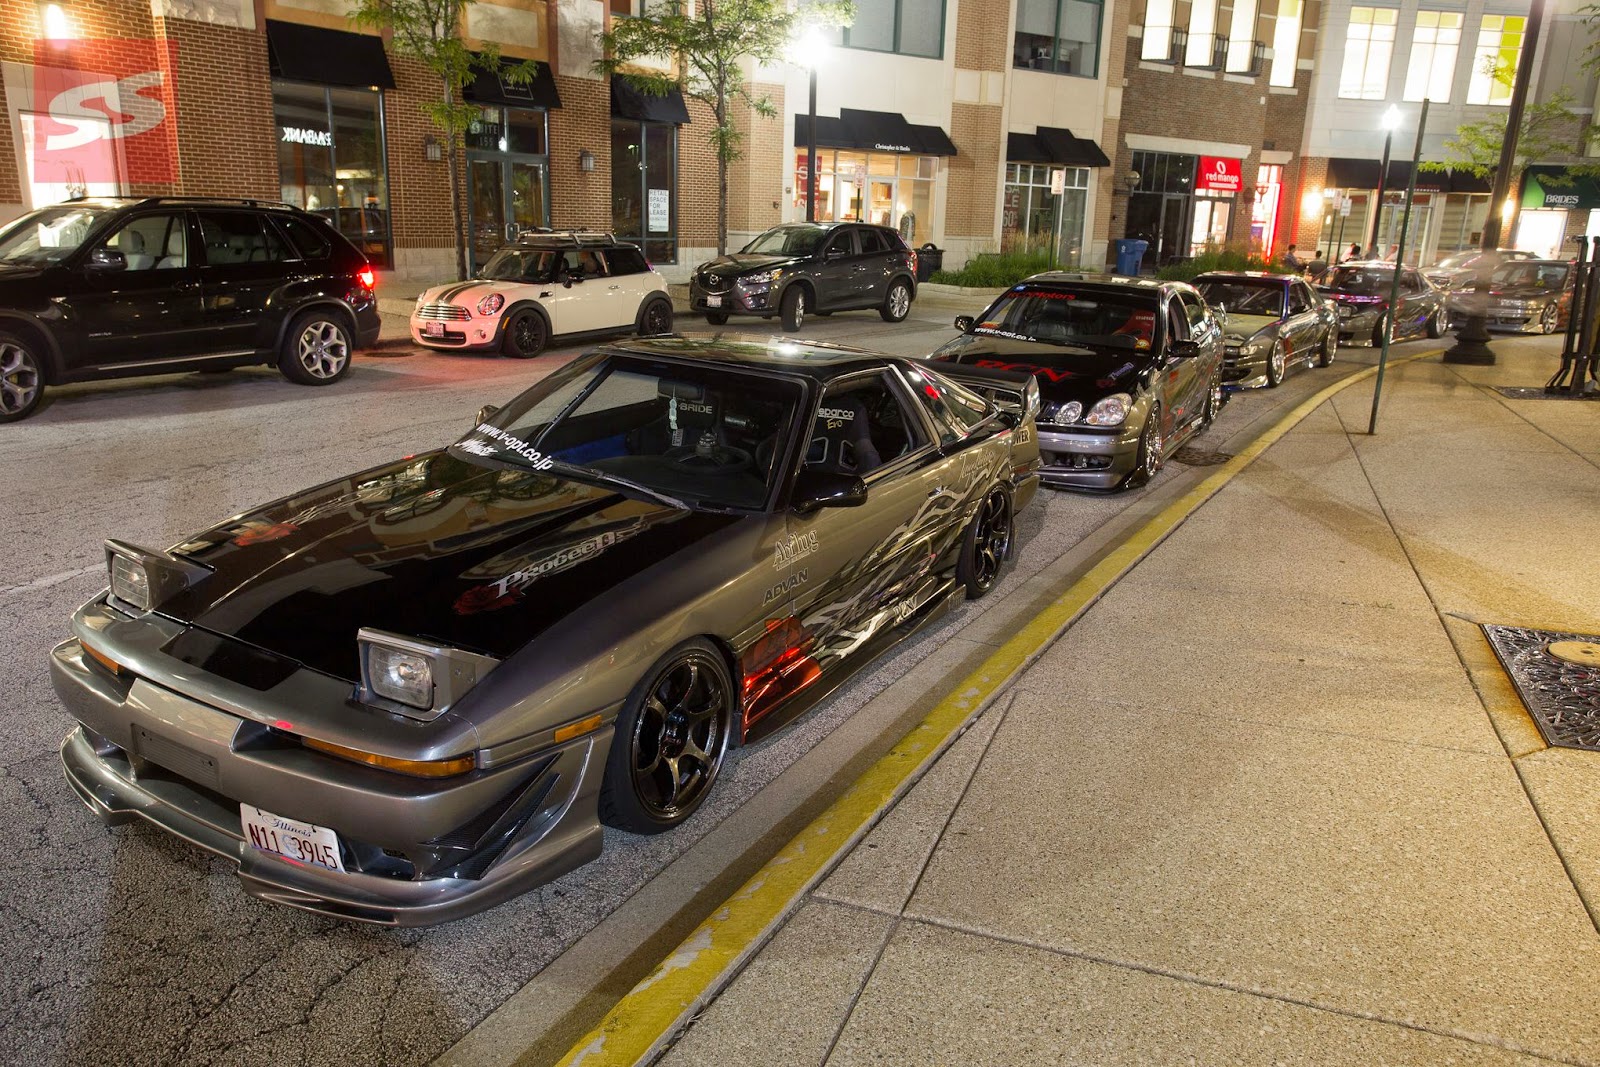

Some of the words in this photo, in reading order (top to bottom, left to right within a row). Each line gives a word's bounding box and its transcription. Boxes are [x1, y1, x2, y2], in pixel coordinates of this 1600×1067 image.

[1205, 172, 1217, 181] red
[1217, 174, 1239, 184] mango
[1545, 195, 1579, 204] BRIDES
[678, 402, 713, 414] BRIDE
[818, 407, 855, 420] sparco
[475, 422, 554, 471] www.v-opt.co.jp
[762, 566, 809, 608] ADVAN
[261, 814, 314, 838] Illinois
[248, 822, 283, 856] N11
[291, 836, 338, 870] 3945
